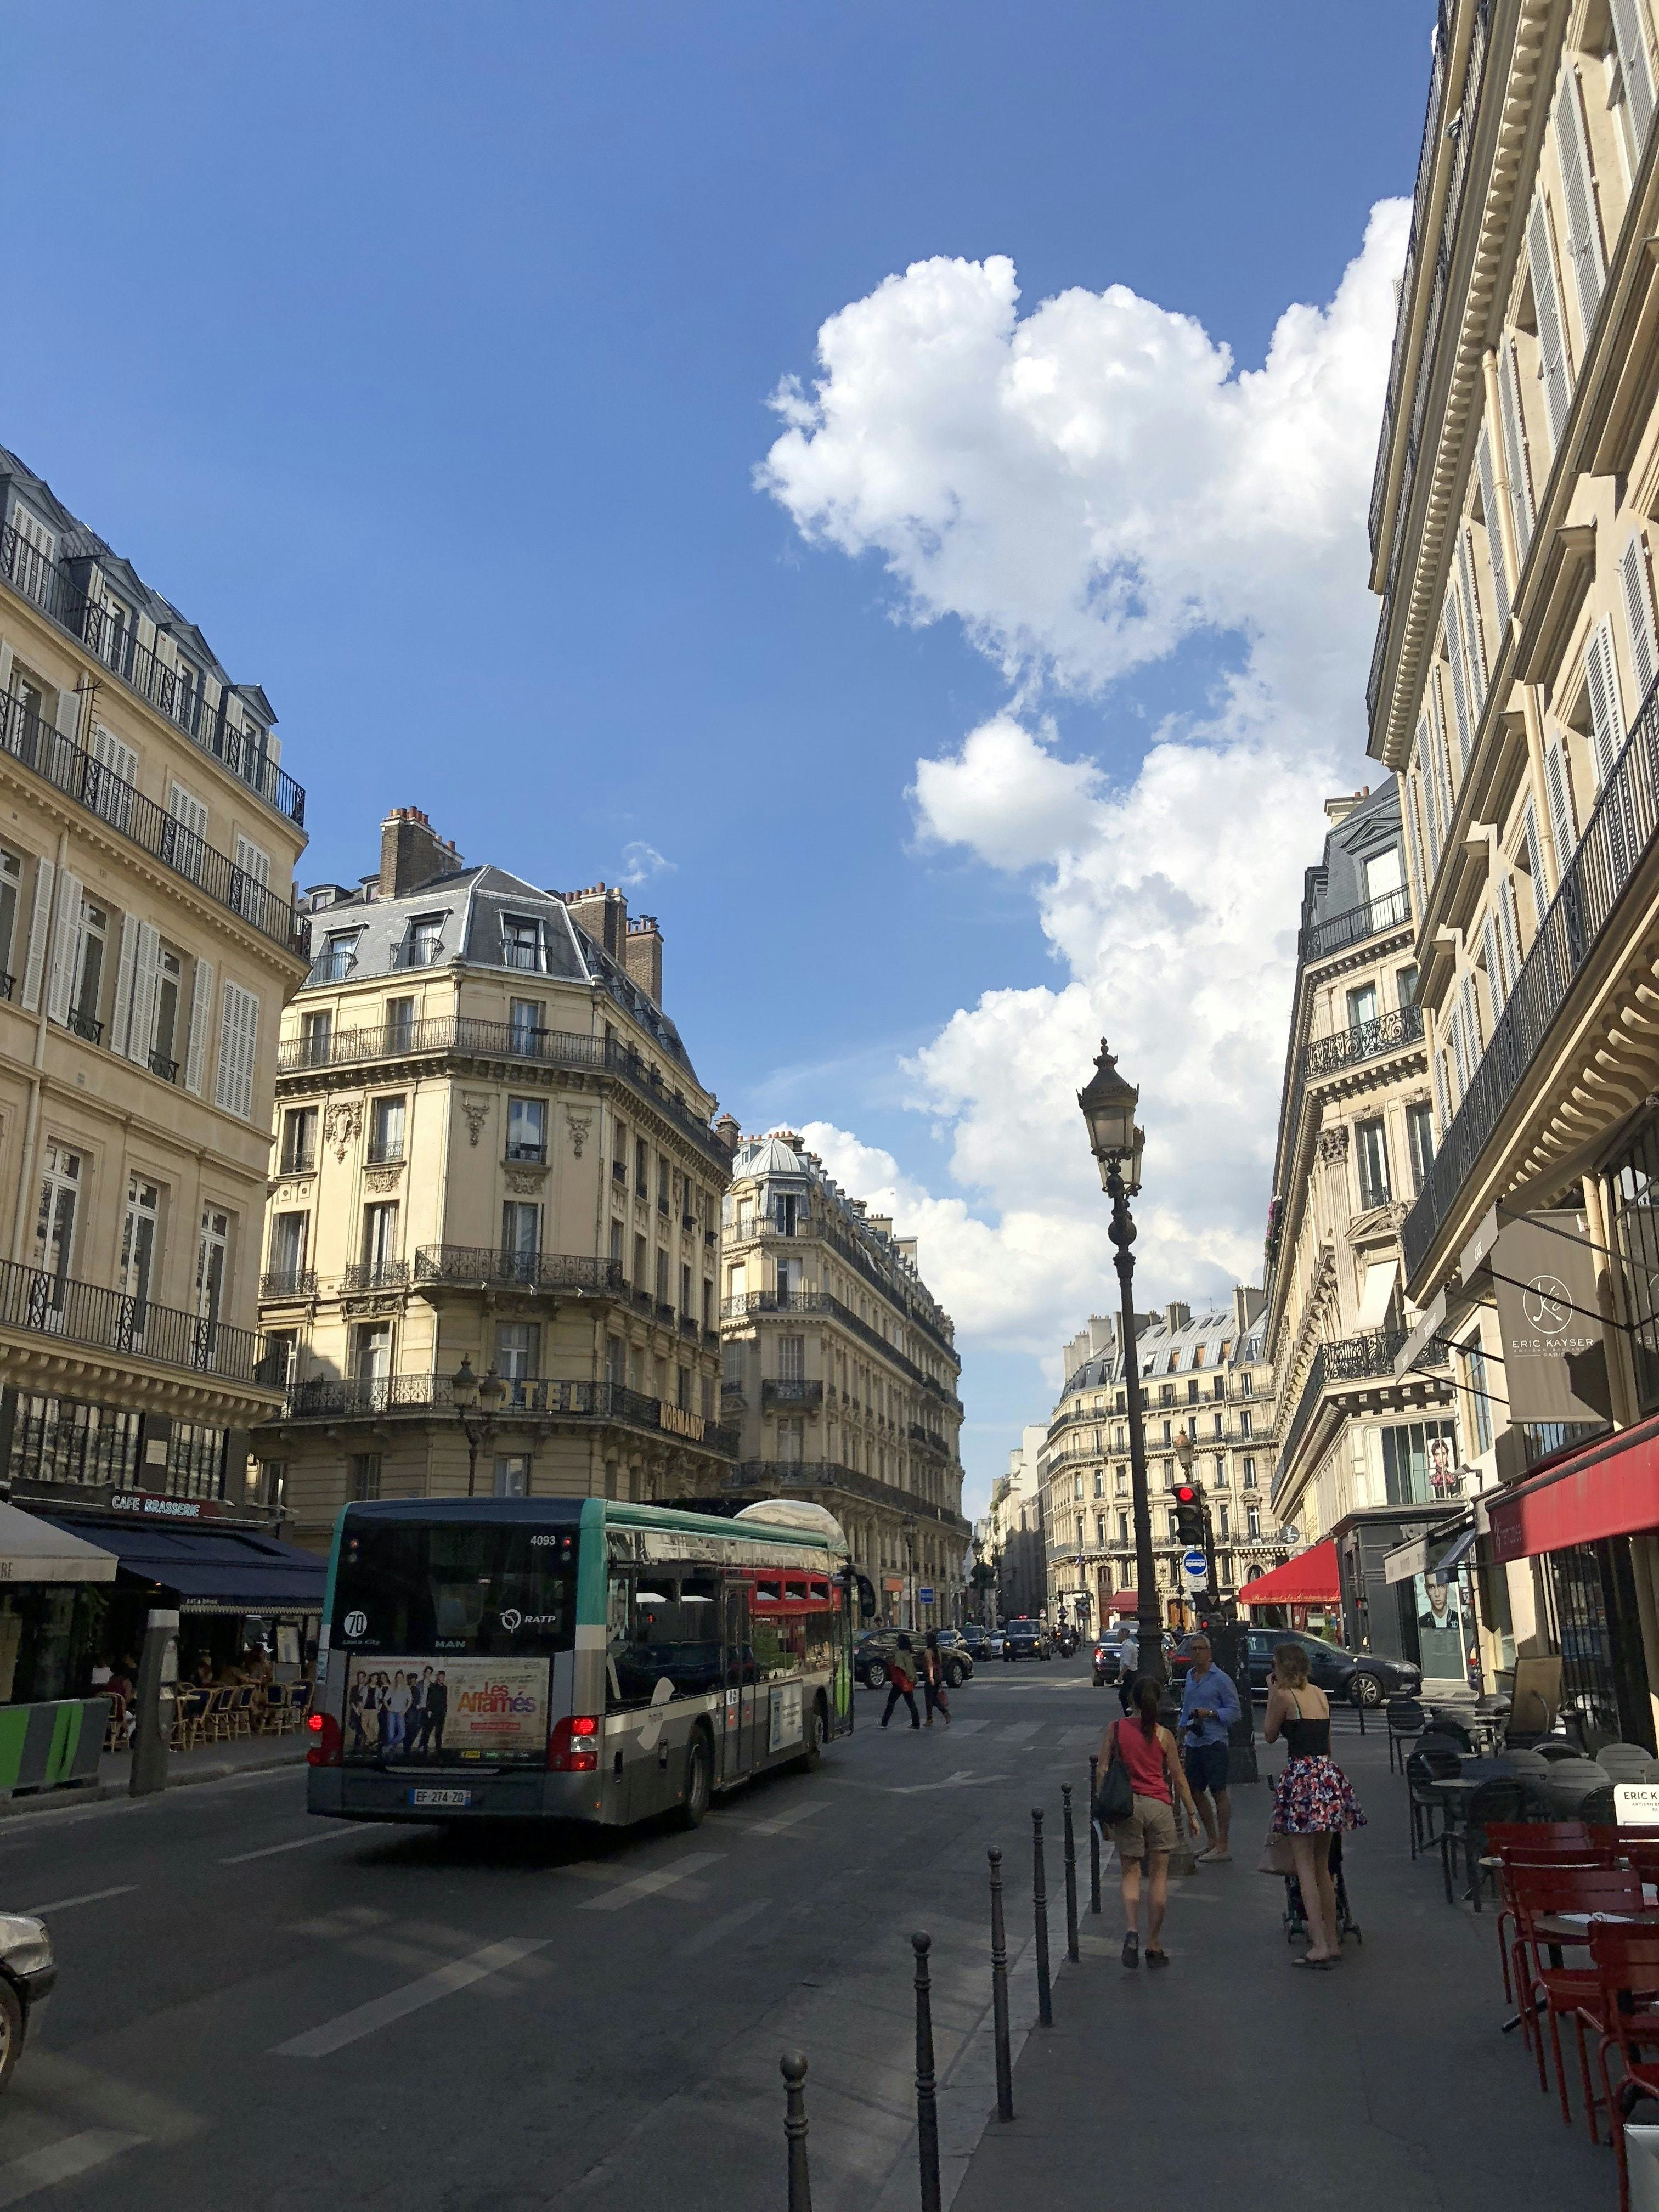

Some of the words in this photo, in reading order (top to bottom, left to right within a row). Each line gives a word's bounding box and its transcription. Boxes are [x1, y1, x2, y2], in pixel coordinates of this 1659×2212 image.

[1512, 1340, 1541, 1348] ERIC
[1545, 1338, 1594, 1347] KAYSER
[144, 1499, 200, 1517] BRASSERIE
[530, 1536, 556, 1545] 4093
[348, 1614, 364, 1634] 70
[484, 1681, 509, 1696] Les
[456, 1690, 537, 1713] Affamés
